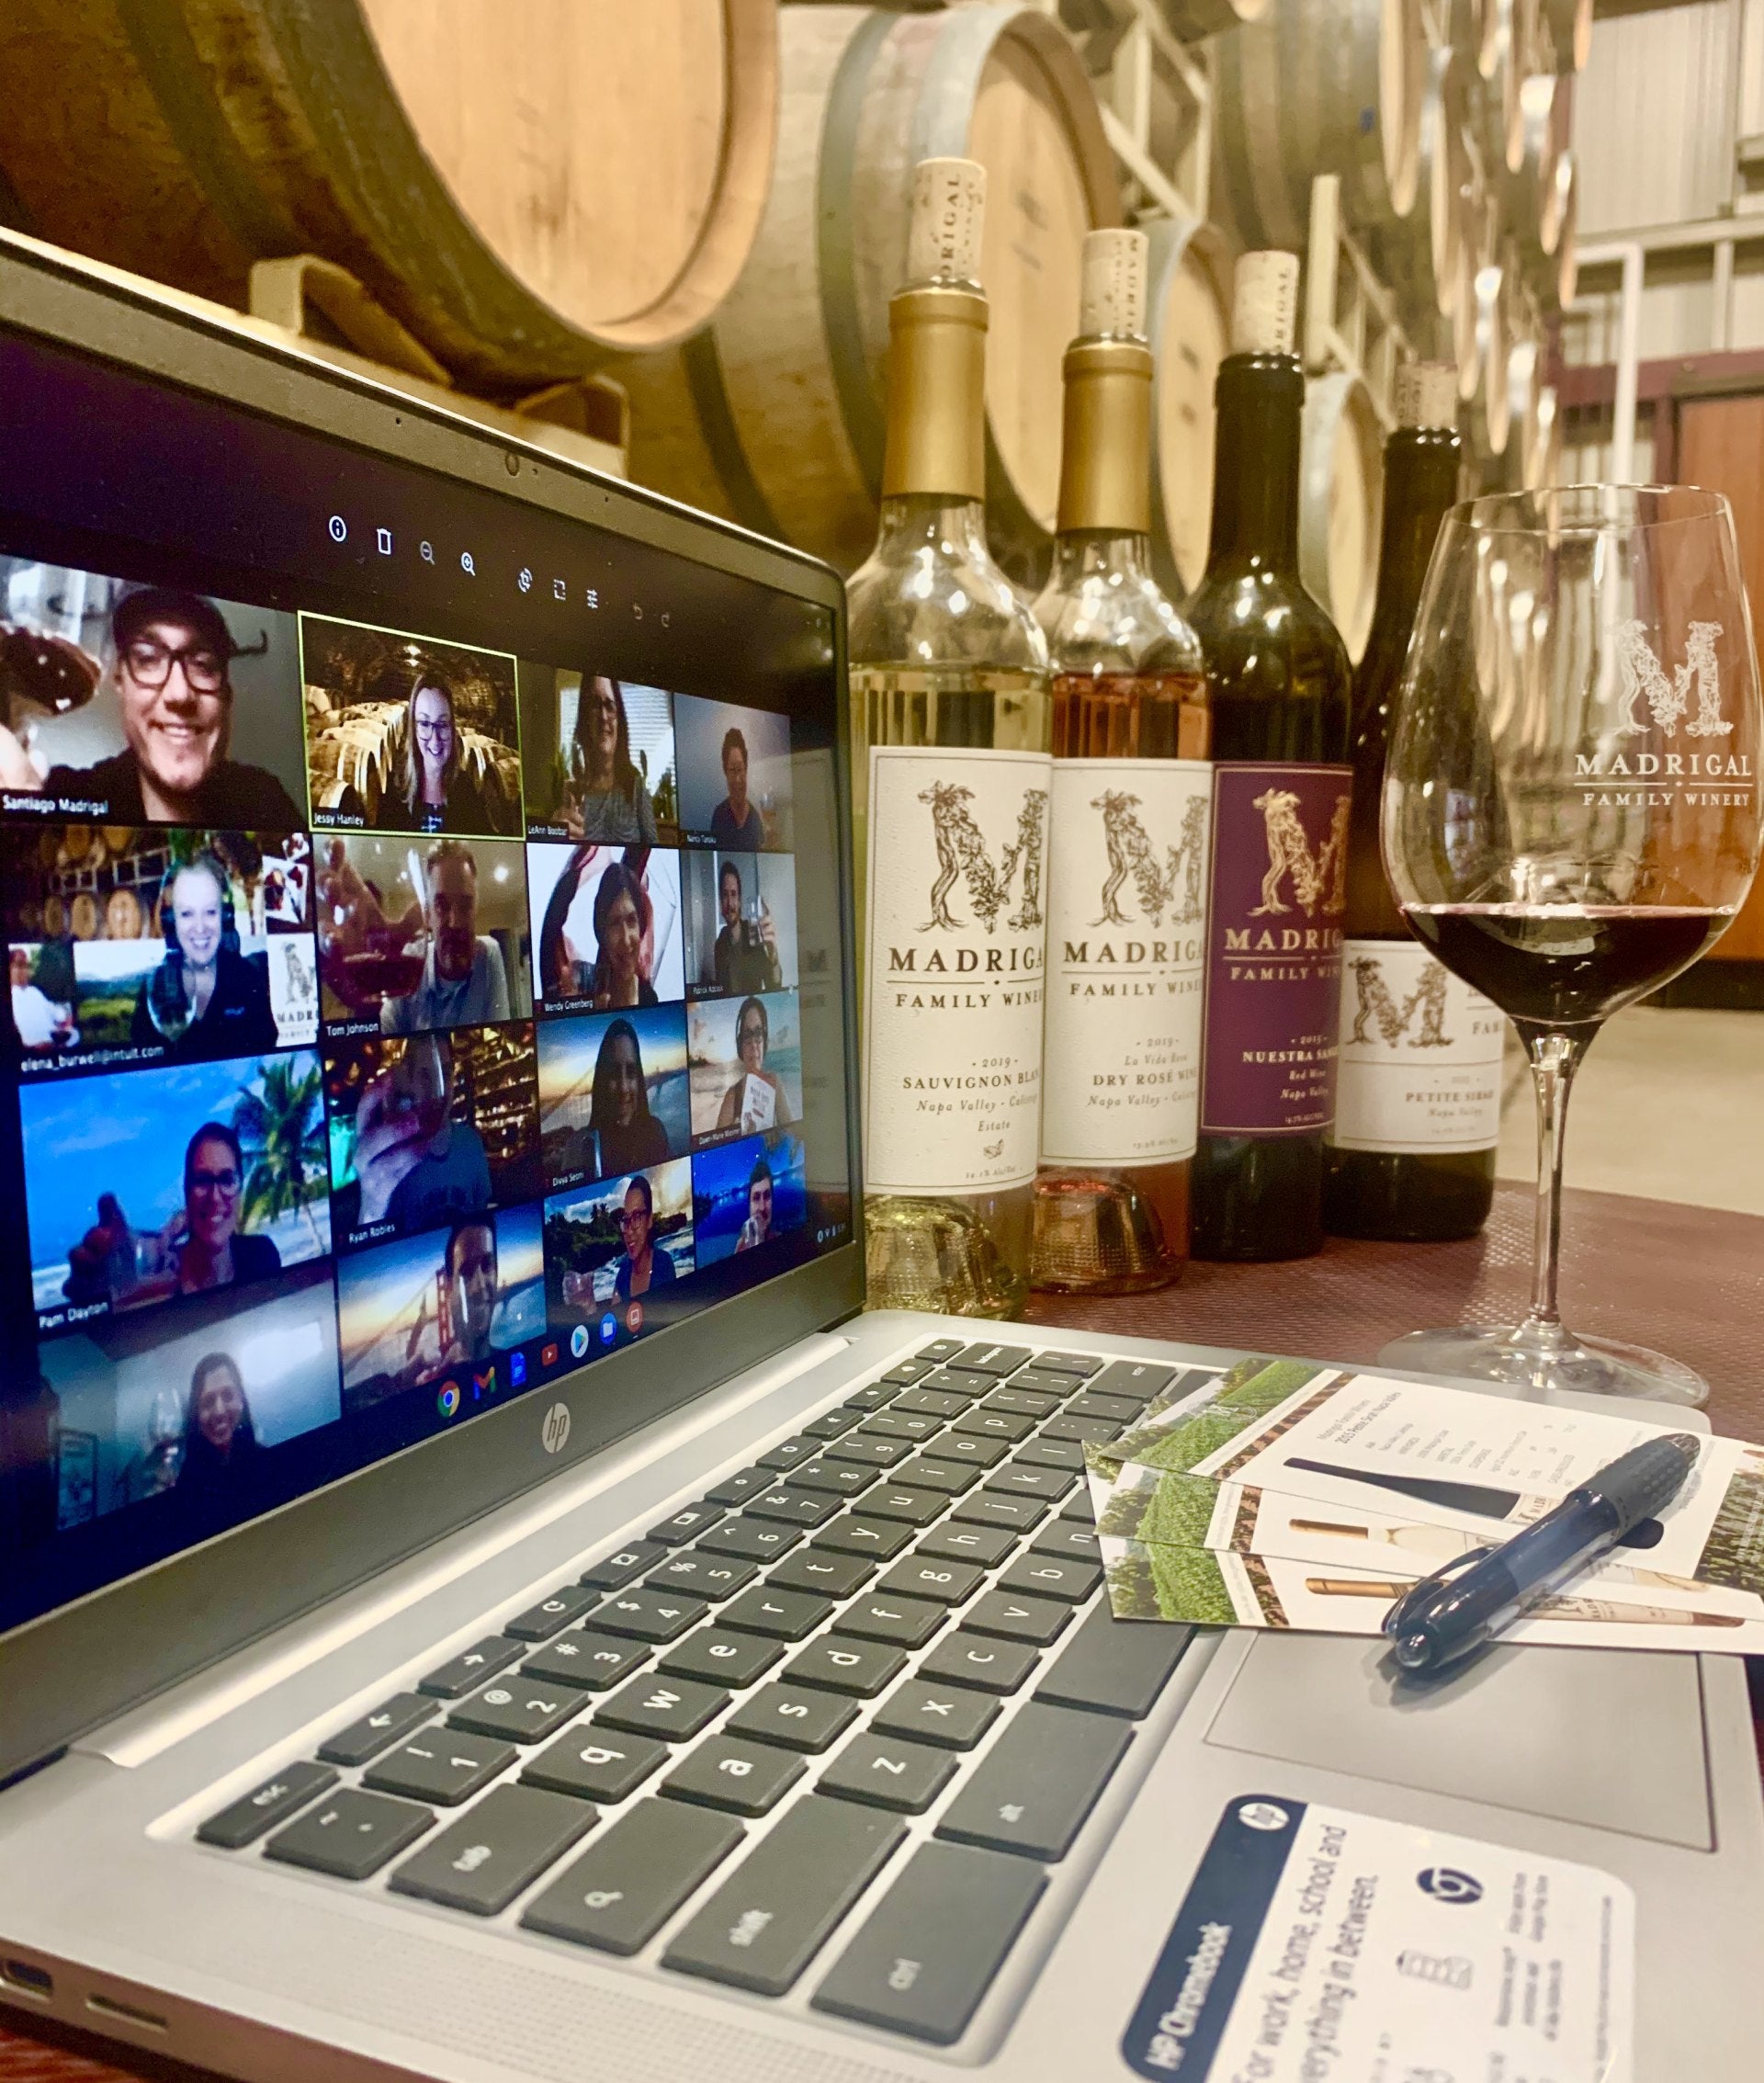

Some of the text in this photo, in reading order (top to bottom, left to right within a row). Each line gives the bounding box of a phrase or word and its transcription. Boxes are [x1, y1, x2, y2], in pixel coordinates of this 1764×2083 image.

[1574, 753, 1753, 776] MADRIGAL
[2, 794, 109, 817] Santiago Madrigal
[1582, 793, 1750, 807] FAMILY WINERY
[313, 812, 365, 827] Jessy Hanley
[1230, 967, 1308, 980] FAMILY
[1069, 983, 1157, 996] FAMILY
[896, 993, 991, 1009] FAMILY
[326, 1022, 379, 1037] Tom Johnson
[981, 1057, 1011, 1069] 2019
[1242, 1050, 1314, 1063] NUESTRA
[902, 1075, 1012, 1090] SAUVIGNON
[1092, 1075, 1128, 1086] DRY
[916, 1100, 953, 1115] Napa
[960, 1099, 996, 1114] Valley
[1087, 1095, 1122, 1110] Napa
[978, 1120, 1011, 1132] Estate
[348, 1223, 397, 1245] Ryan Robles
[40, 1314, 65, 1330] Pam
[985, 1419, 1009, 1428] p
[956, 1442, 977, 1450] o
[1013, 1474, 1042, 1483] k
[889, 1496, 914, 1506] u
[851, 1527, 880, 1540] y
[947, 1534, 981, 1545] h
[807, 1564, 834, 1573] t
[920, 1569, 953, 1582] g
[1030, 1568, 1064, 1579] b
[762, 1602, 785, 1613] r
[871, 1607, 903, 1619] f
[1003, 1606, 1030, 1618] v
[594, 1652, 622, 1663] 3
[709, 1645, 737, 1658] e
[827, 1650, 863, 1666] d
[967, 1650, 995, 1663] c
[526, 1700, 557, 1714] 2
[642, 1690, 681, 1709] w
[778, 1703, 809, 1718] s
[921, 1700, 955, 1715] x
[579, 1746, 627, 1764] q
[718, 1759, 754, 1777] a
[872, 1757, 907, 1774] z
[1318, 1823, 1347, 1857] and
[1296, 1857, 1337, 1917] school
[1326, 1874, 1380, 1959] between.
[1269, 1921, 1322, 1983] home,
[1319, 1959, 1356, 1980] in
[1143, 1920, 1233, 2072] HP Chromebook
[1256, 1988, 1301, 2046] work,
